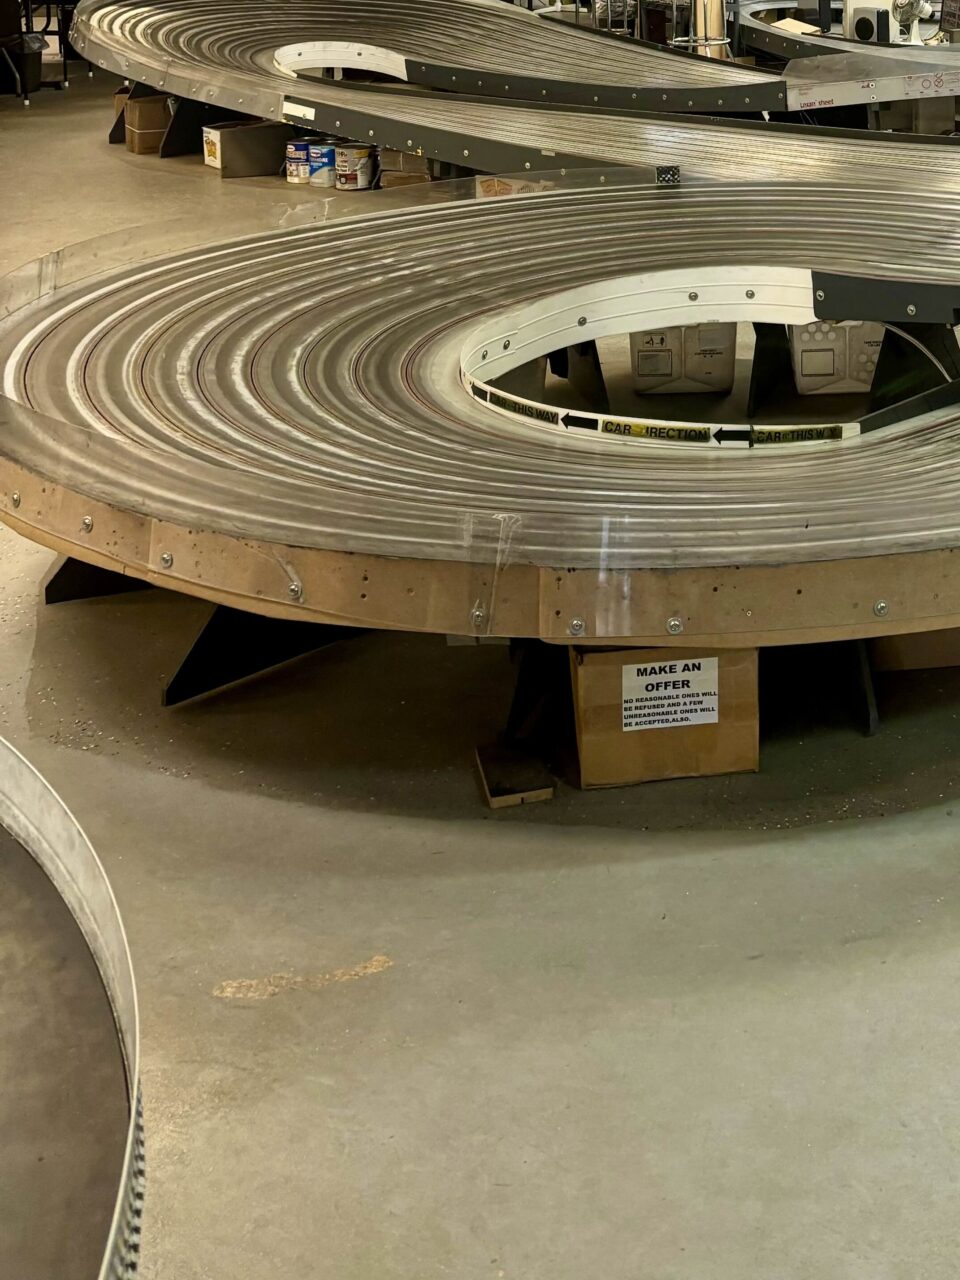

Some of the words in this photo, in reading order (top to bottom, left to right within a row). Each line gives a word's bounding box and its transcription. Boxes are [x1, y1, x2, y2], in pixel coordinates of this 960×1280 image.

[513, 402, 533, 417] THIS
[535, 408, 556, 423] WAY
[605, 421, 632, 435] CAR
[644, 426, 707, 441] IRECTION
[789, 429, 813, 440] THIS
[816, 427, 837, 439] WY
[636, 664, 677, 677] MAKE
[682, 662, 701, 673] AN
[645, 680, 691, 692] OFFER
[635, 695, 680, 703] REASONABLE
[634, 703, 665, 711] REFUSED
[624, 710, 678, 719] UNREASONABLE
